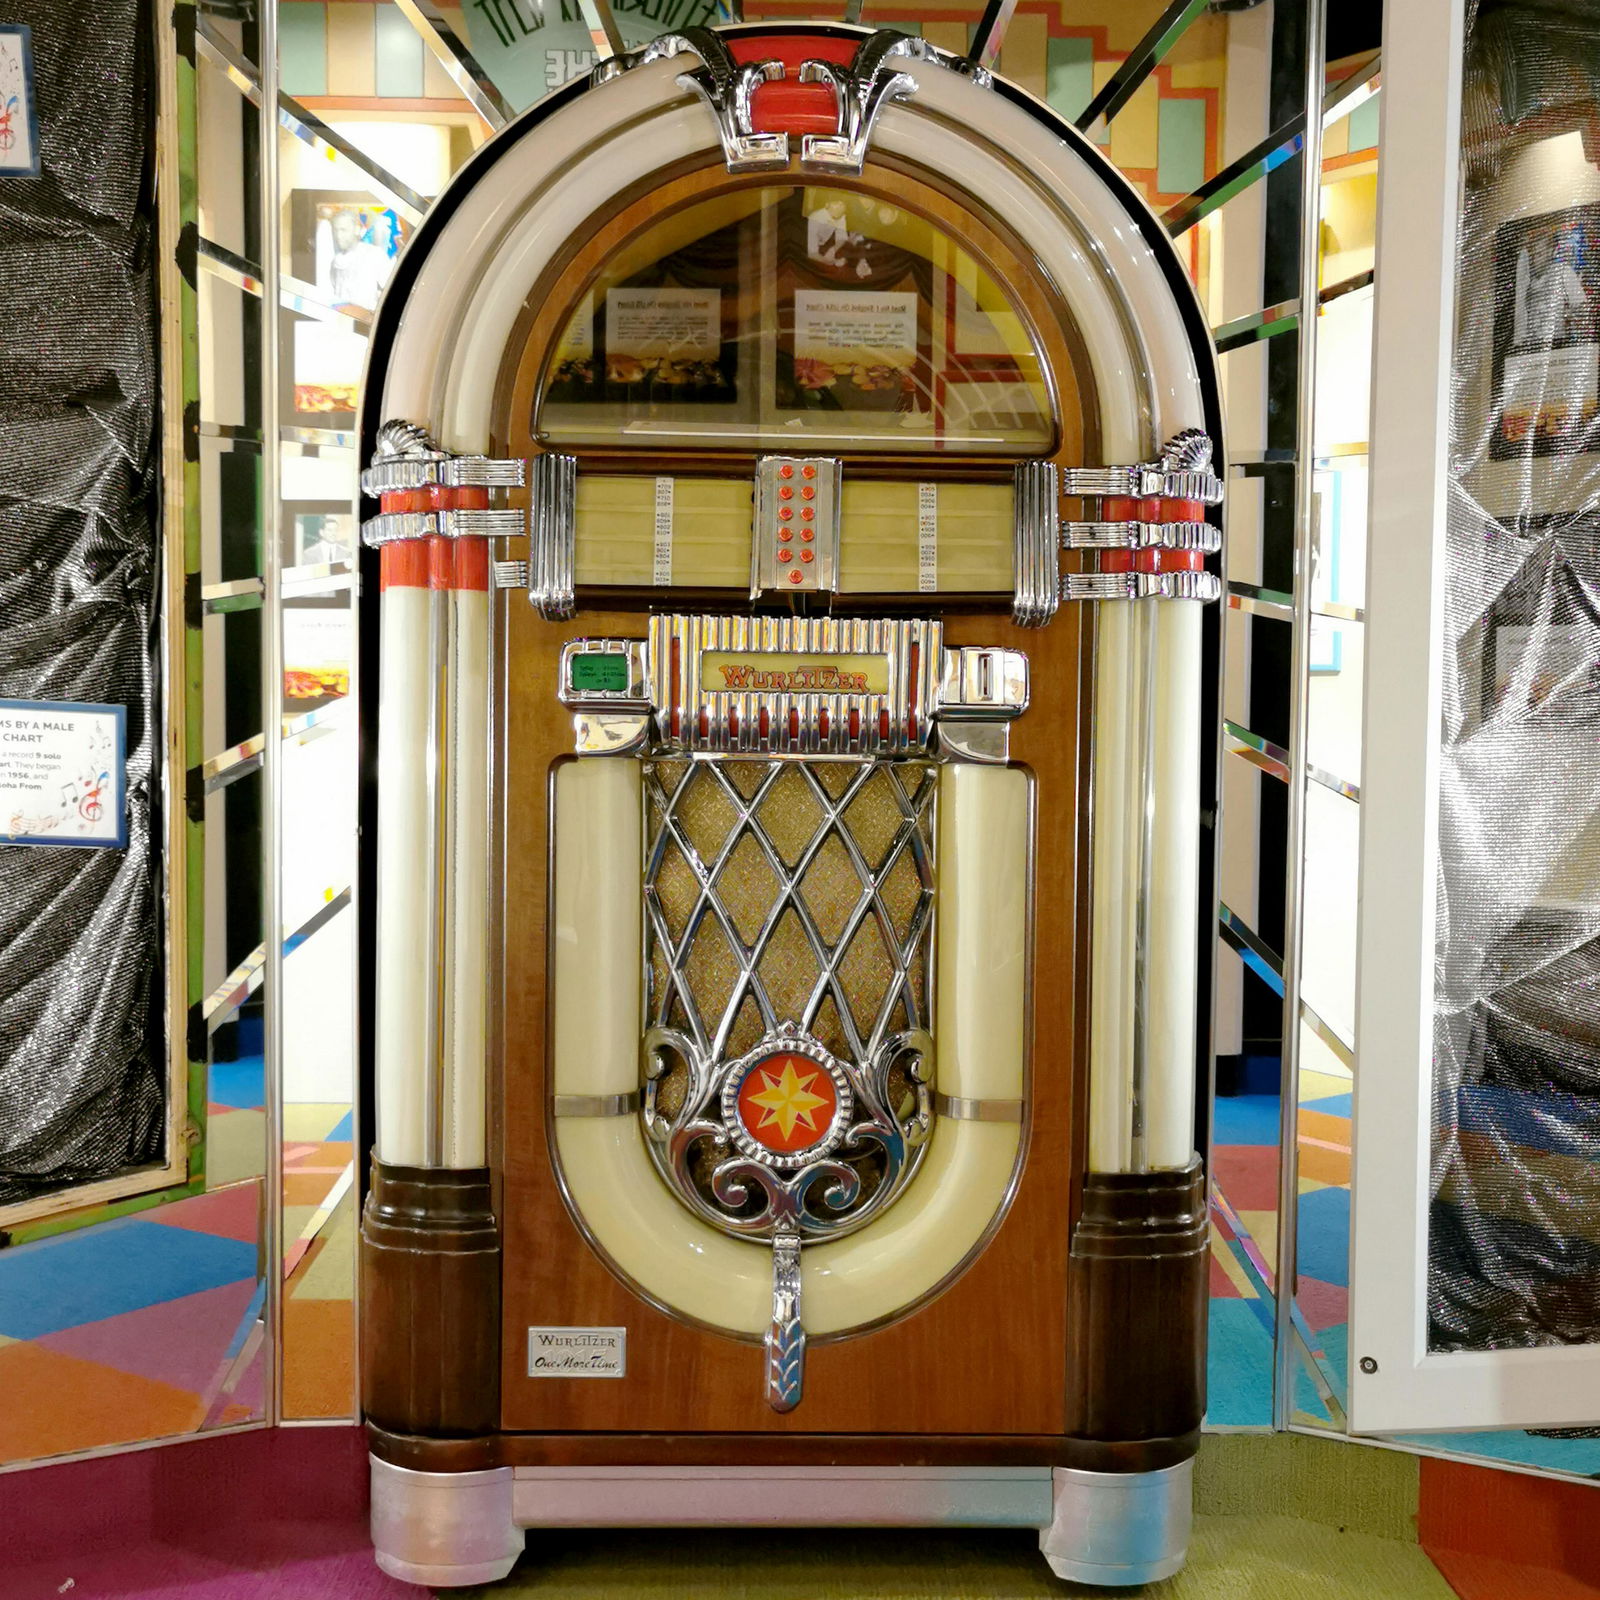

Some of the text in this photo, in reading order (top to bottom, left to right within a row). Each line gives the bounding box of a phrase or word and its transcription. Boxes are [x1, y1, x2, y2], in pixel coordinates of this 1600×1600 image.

[719, 664, 870, 693] WURLITZER
[16, 720, 29, 729] BY
[43, 722, 74, 731] MALE
[3, 733, 44, 742] CHART
[14, 761, 34, 770] They
[538, 1334, 616, 1348] WURLITZER
[535, 1356, 618, 1368] One More Time
